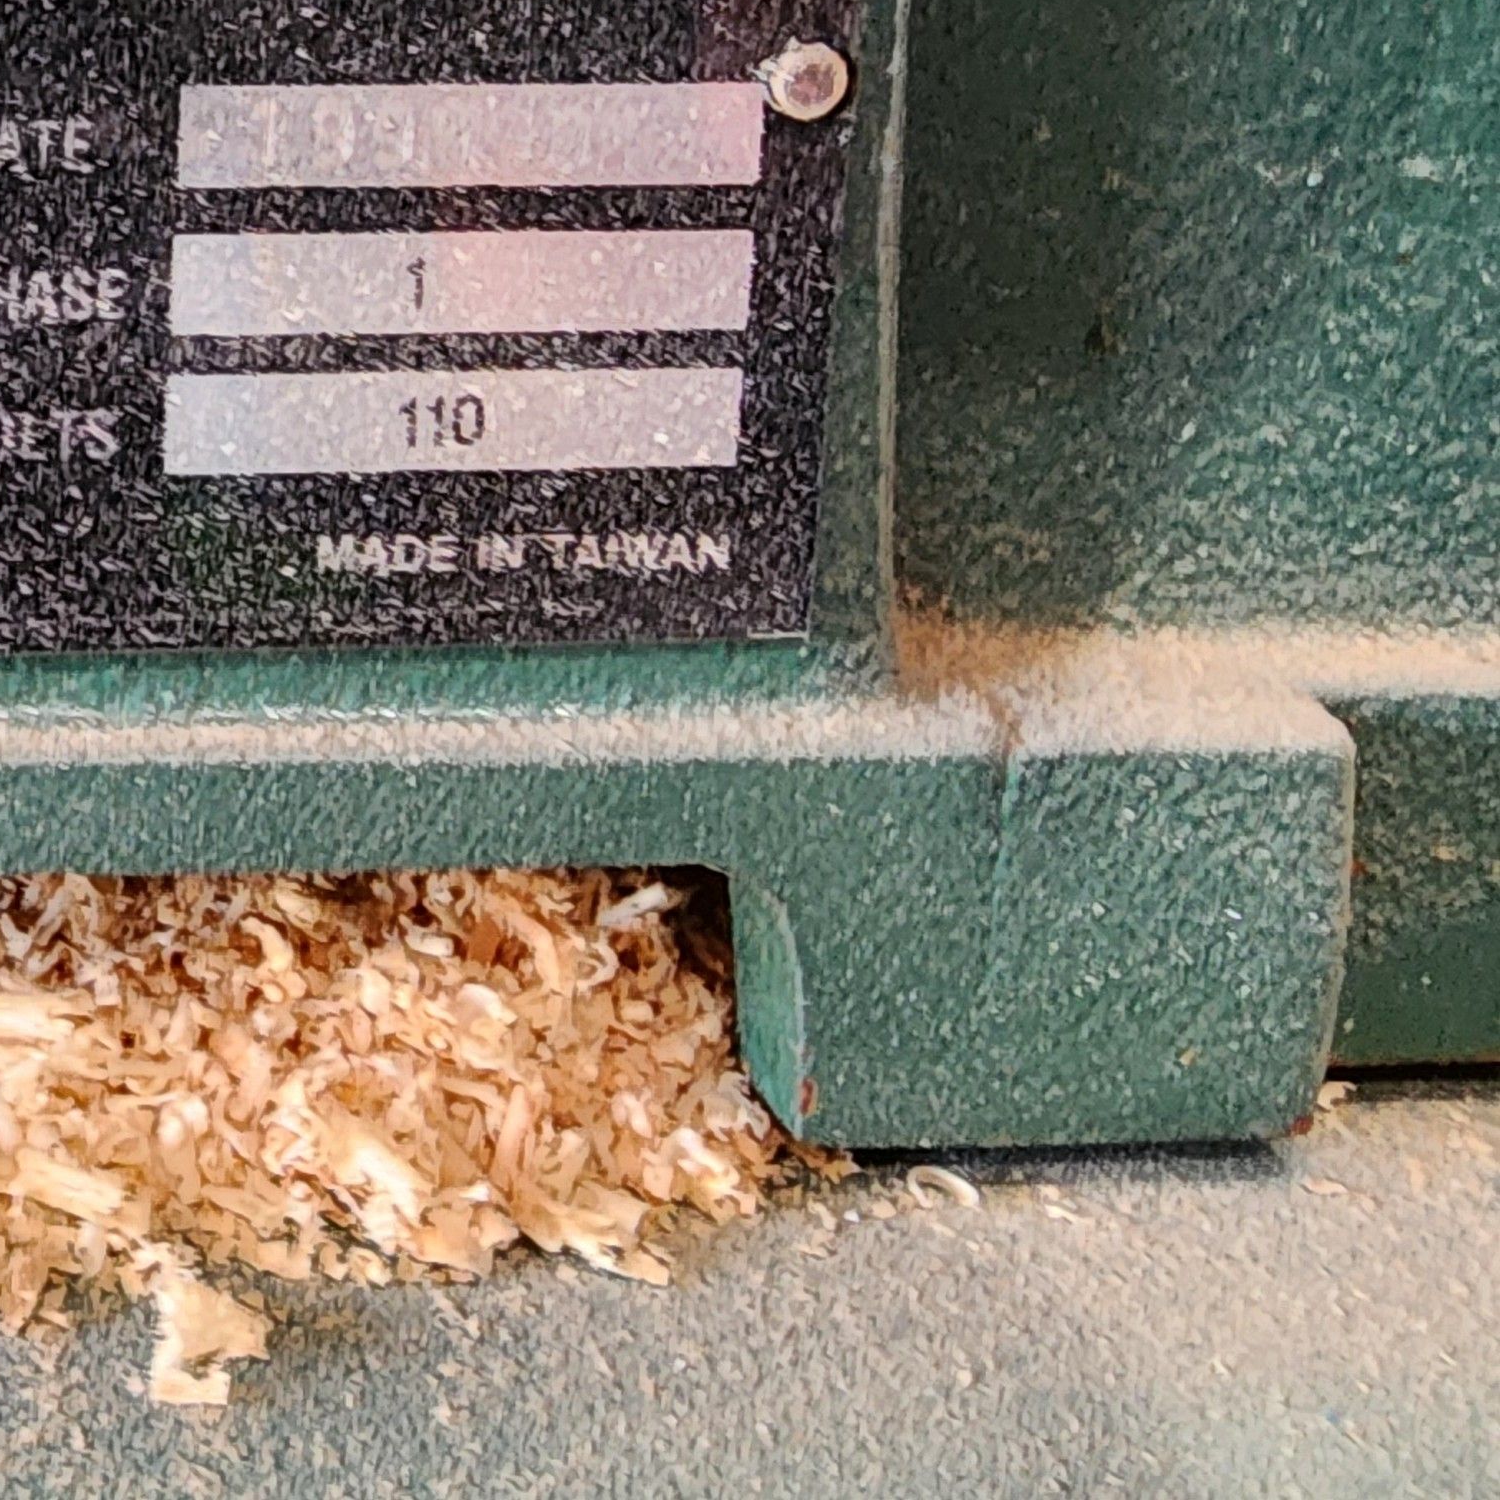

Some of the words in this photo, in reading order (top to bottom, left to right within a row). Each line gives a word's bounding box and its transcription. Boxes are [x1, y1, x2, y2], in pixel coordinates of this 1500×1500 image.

[397, 396, 485, 446] 110
[315, 532, 456, 575] MADE
[472, 532, 525, 573] IN
[543, 530, 733, 573] TAIWAN
